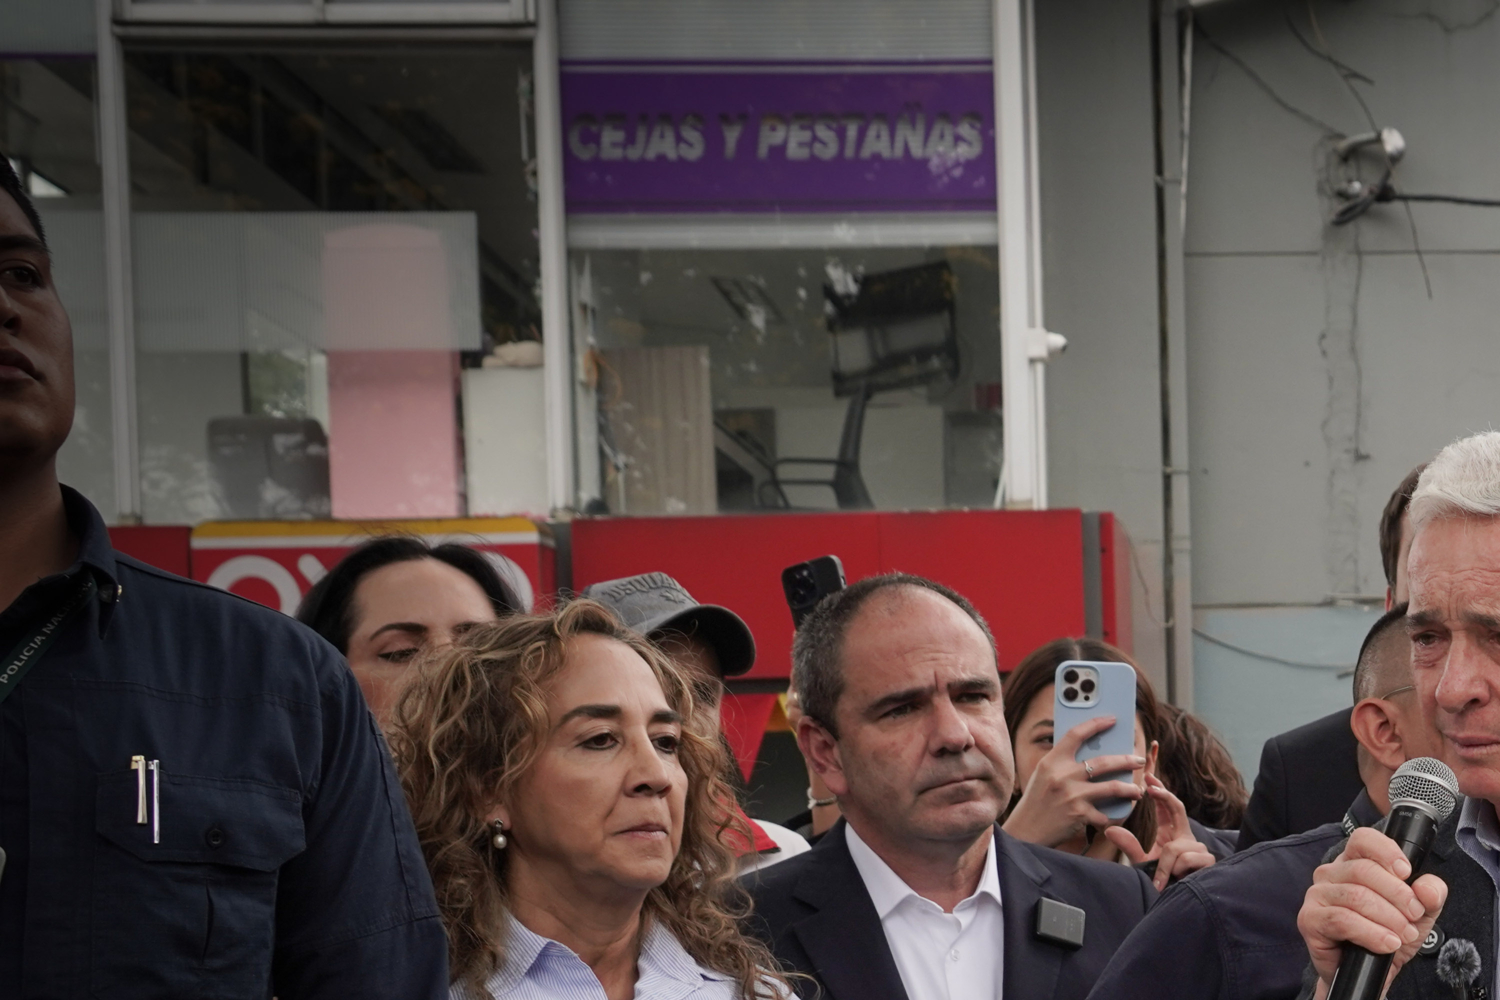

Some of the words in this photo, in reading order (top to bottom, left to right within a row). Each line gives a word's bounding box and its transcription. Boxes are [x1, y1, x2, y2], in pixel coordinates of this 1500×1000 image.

[568, 113, 705, 161] CEJAS
[718, 114, 748, 161] Y
[757, 103, 983, 161] PESTAÑAS
